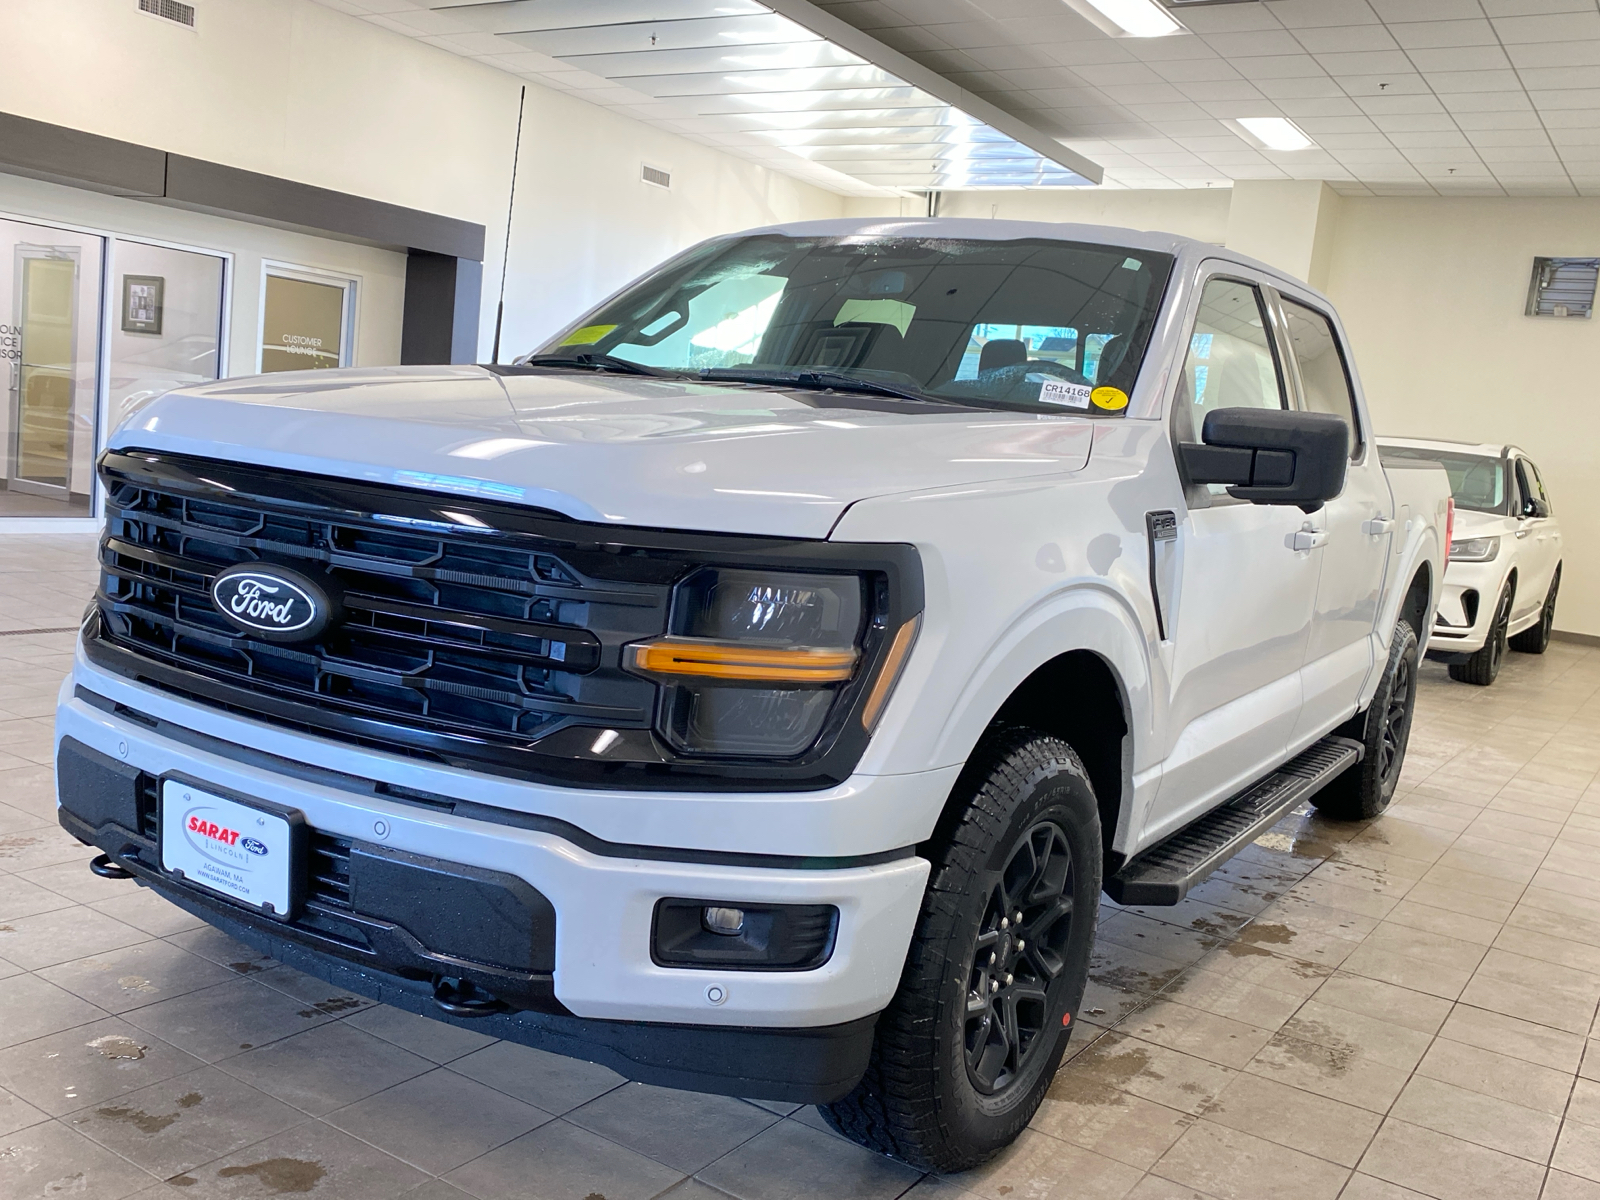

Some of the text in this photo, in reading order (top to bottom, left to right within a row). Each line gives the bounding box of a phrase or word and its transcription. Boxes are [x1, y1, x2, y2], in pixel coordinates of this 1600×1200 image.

[0, 337, 17, 347] ICE
[282, 334, 322, 347] CUSTOMER
[286, 345, 317, 357] LOUNGE
[1045, 383, 1091, 398] CR14168
[229, 577, 297, 626] Ford
[188, 816, 240, 846] SARAT
[210, 841, 243, 860] LINCOLN
[244, 838, 265, 855] Ford
[197, 869, 250, 894] WWW.SARATFORD.COM
[203, 863, 244, 884] AGAWAM, MA
